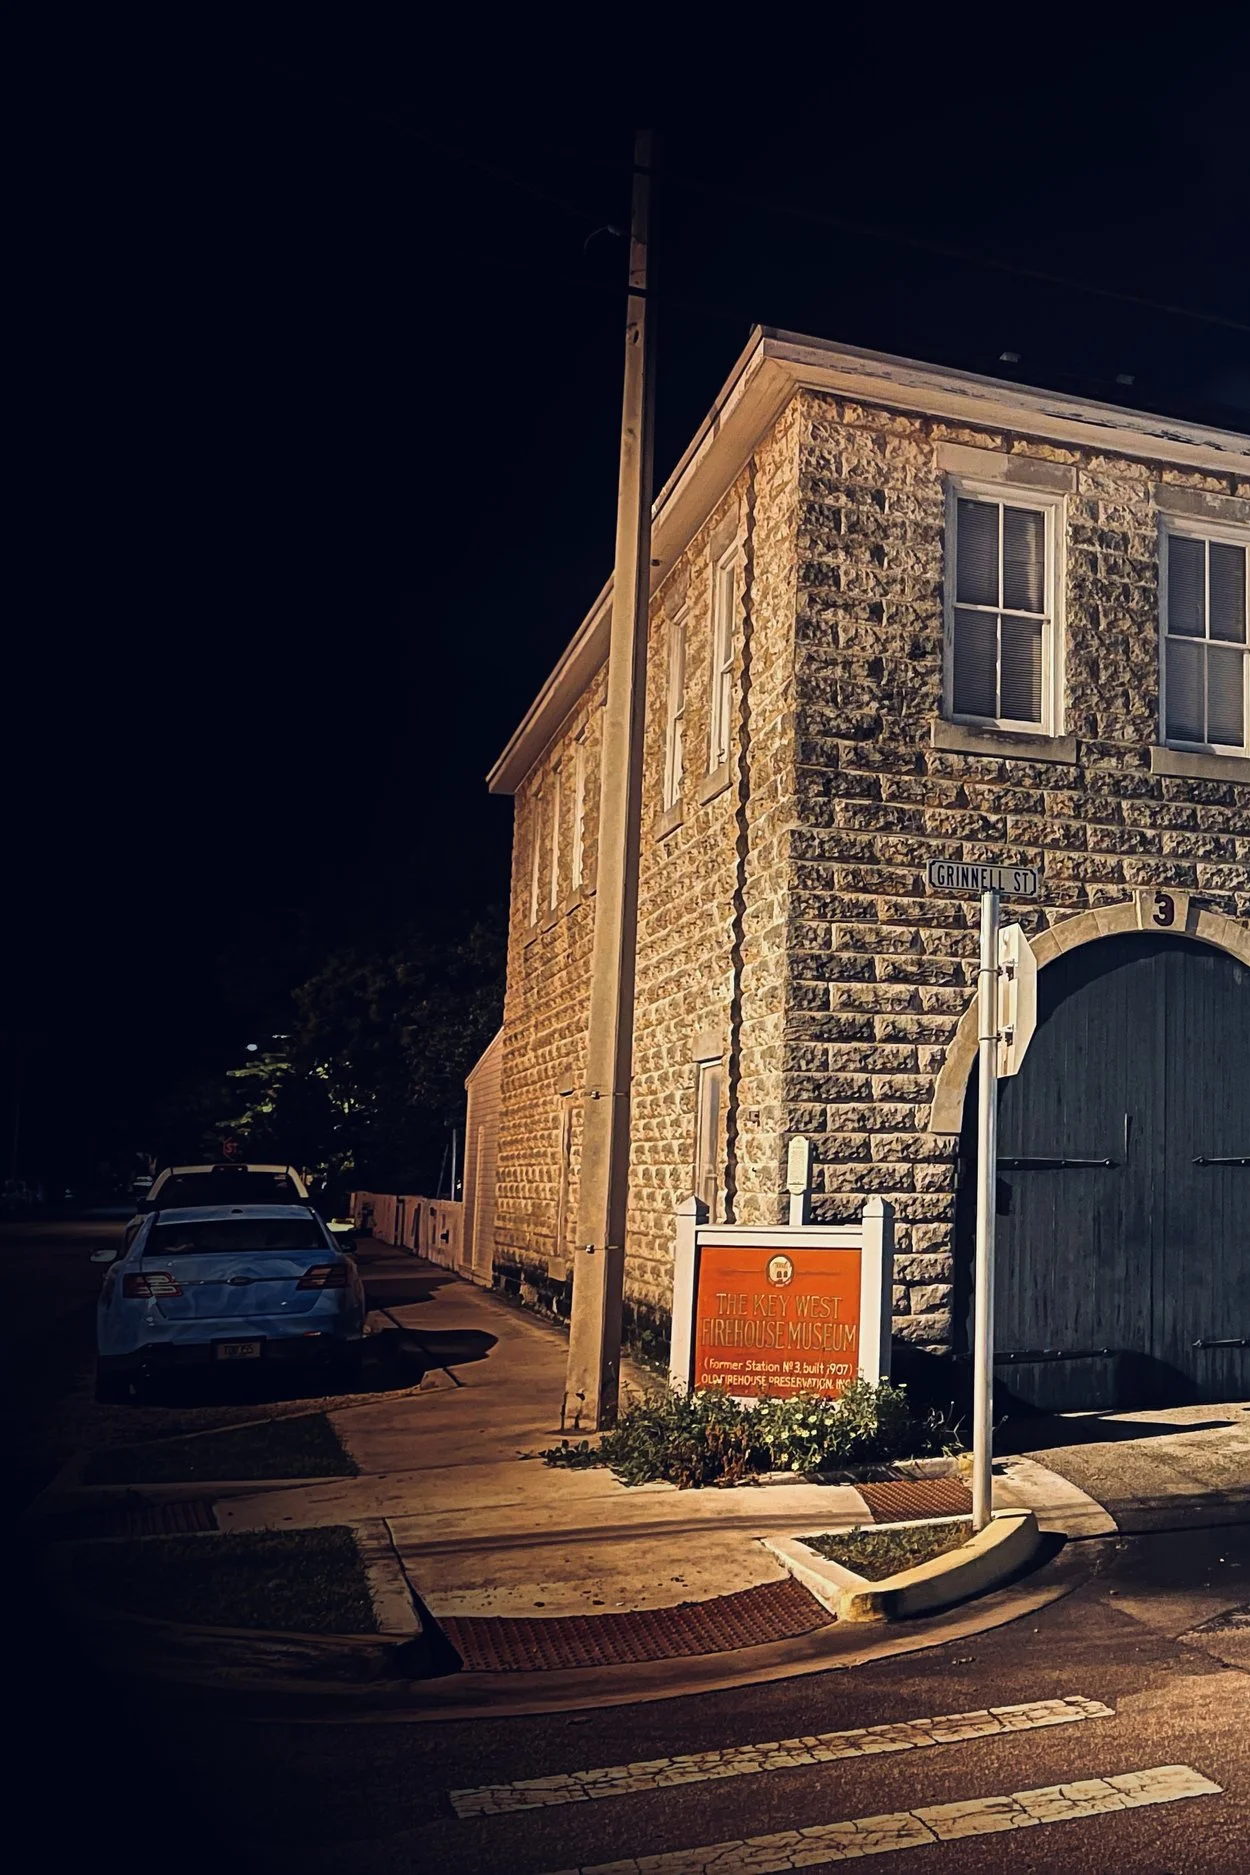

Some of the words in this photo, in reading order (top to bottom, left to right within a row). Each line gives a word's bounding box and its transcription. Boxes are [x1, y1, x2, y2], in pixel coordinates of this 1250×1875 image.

[937, 864, 1005, 891] GRINNELL
[1013, 871, 1029, 893] ST
[1153, 893, 1175, 927] 3
[716, 1293, 748, 1316] THE
[753, 1293, 788, 1317] KEY
[796, 1295, 842, 1319] WEST
[702, 1318, 785, 1350] FIREHOUSE
[787, 1322, 857, 1352] MUSEUM
[704, 1356, 744, 1371] (Former
[745, 1359, 780, 1372] Station
[803, 1361, 825, 1375] built
[701, 1373, 719, 1385] OLD
[719, 1374, 767, 1386] FIREHOUSE
